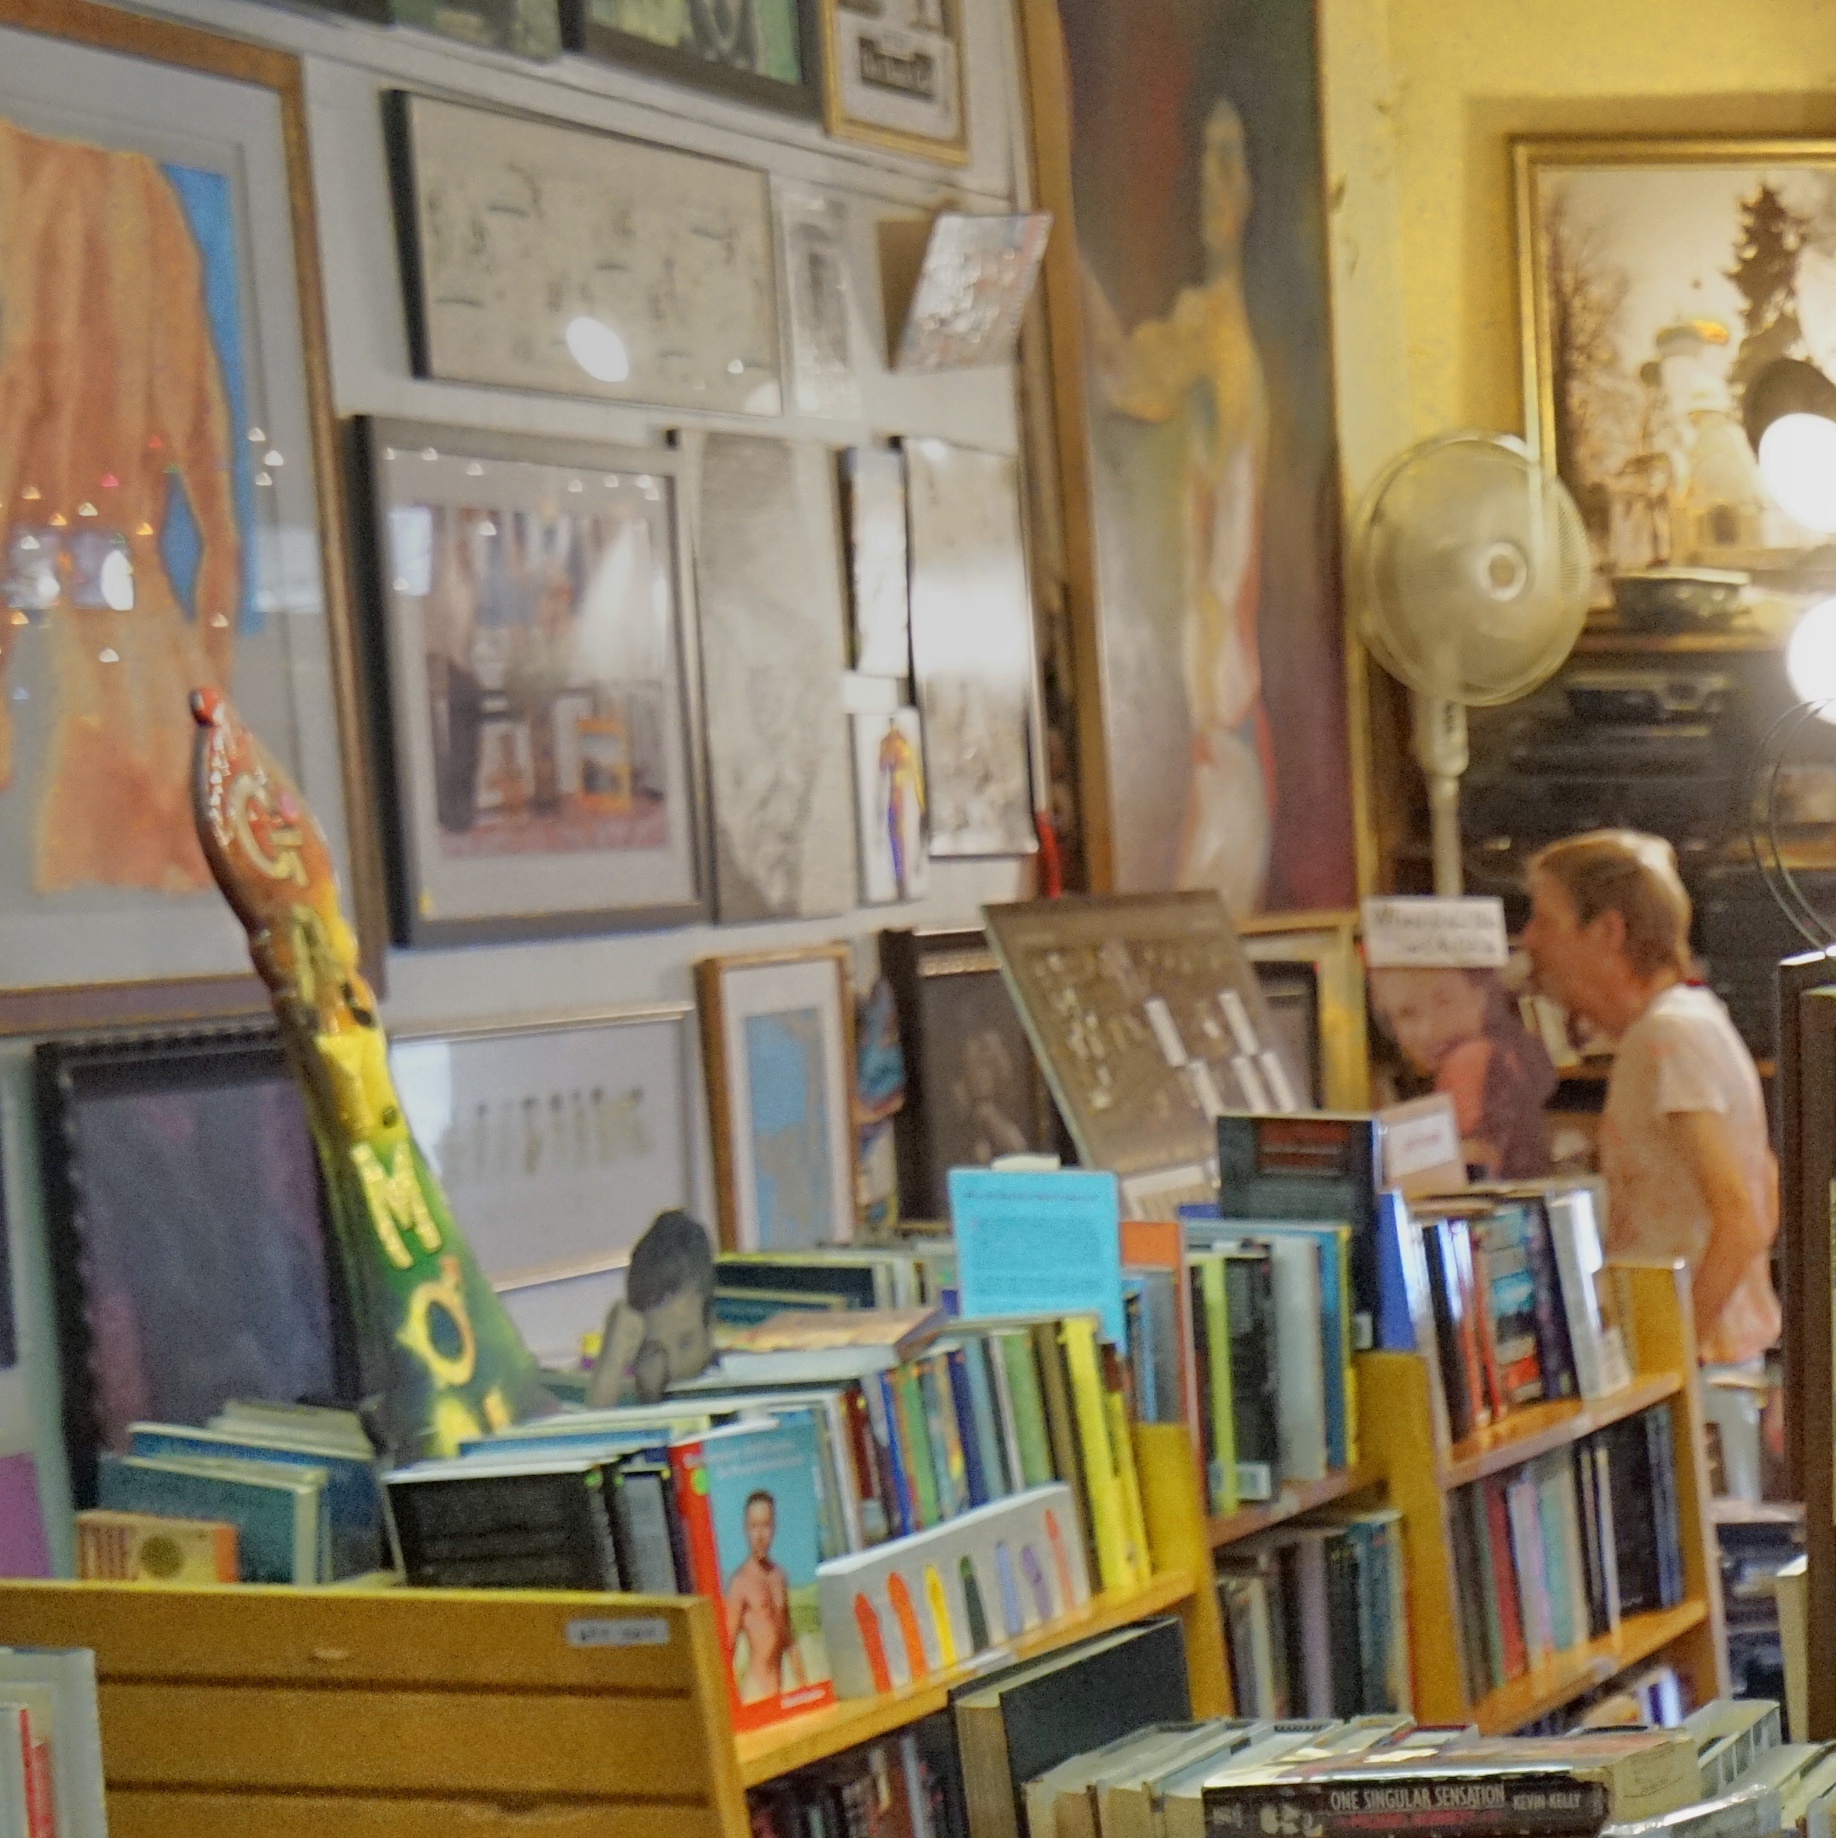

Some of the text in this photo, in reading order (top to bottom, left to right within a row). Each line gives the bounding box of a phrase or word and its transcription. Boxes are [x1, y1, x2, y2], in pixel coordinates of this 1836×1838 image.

[1330, 1783, 1505, 1811] ONE SINGULAR SENSATION
